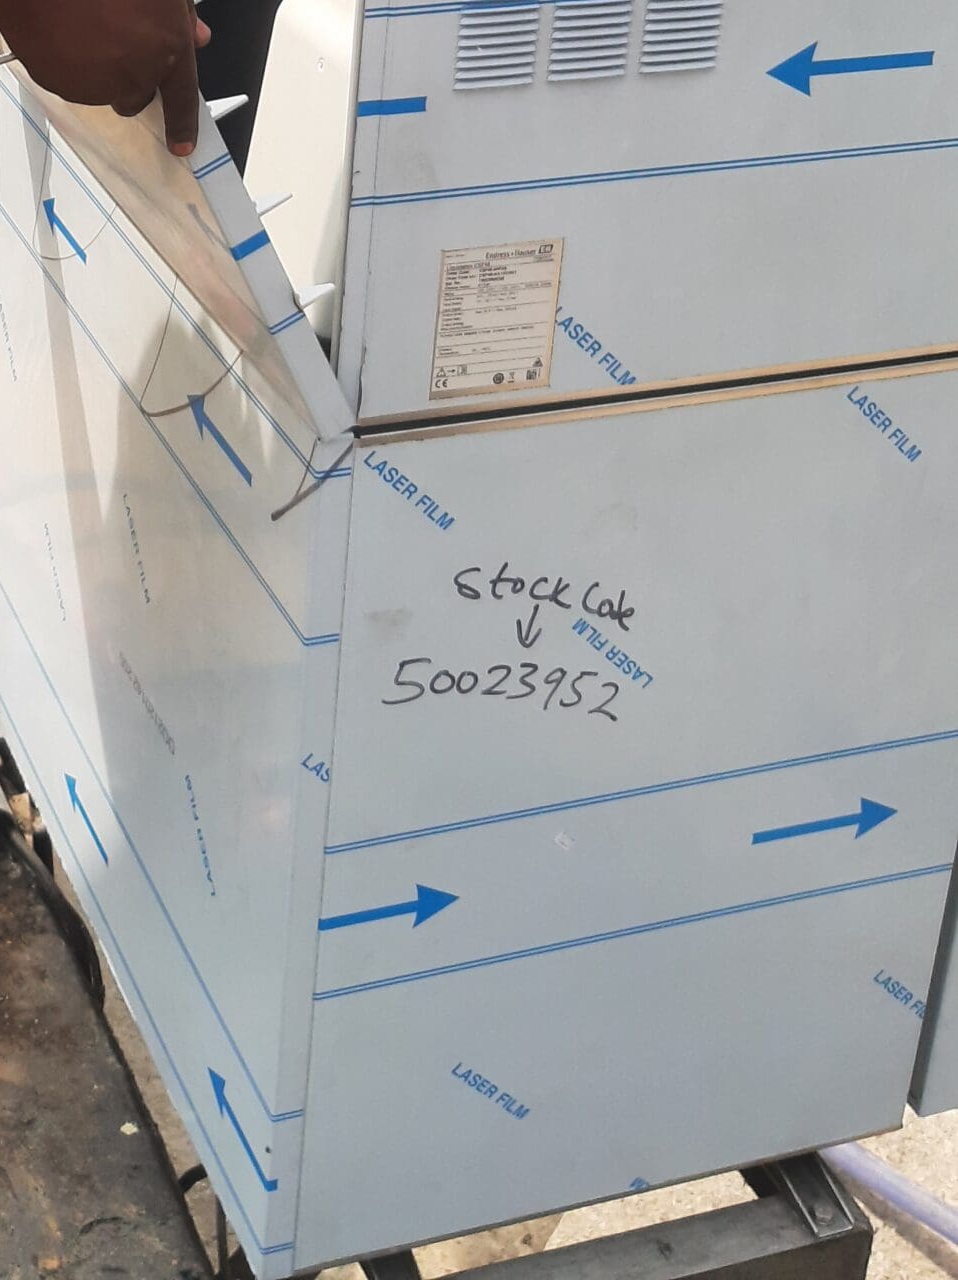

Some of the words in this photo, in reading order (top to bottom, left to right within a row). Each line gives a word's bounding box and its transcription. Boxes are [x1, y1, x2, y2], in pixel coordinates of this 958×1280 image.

[598, 351, 637, 386] FILM
[847, 385, 892, 433] LASER
[888, 427, 922, 462] FILM
[363, 450, 418, 500] LASER
[414, 494, 455, 531] FILM
[453, 562, 572, 609] Stock
[571, 617, 609, 651] FILM
[381, 656, 618, 722] 50023952
[605, 646, 654, 689] LASER
[873, 969, 914, 1005] LASER
[451, 1061, 499, 1099] LASER
[495, 1091, 530, 1120] FILM
